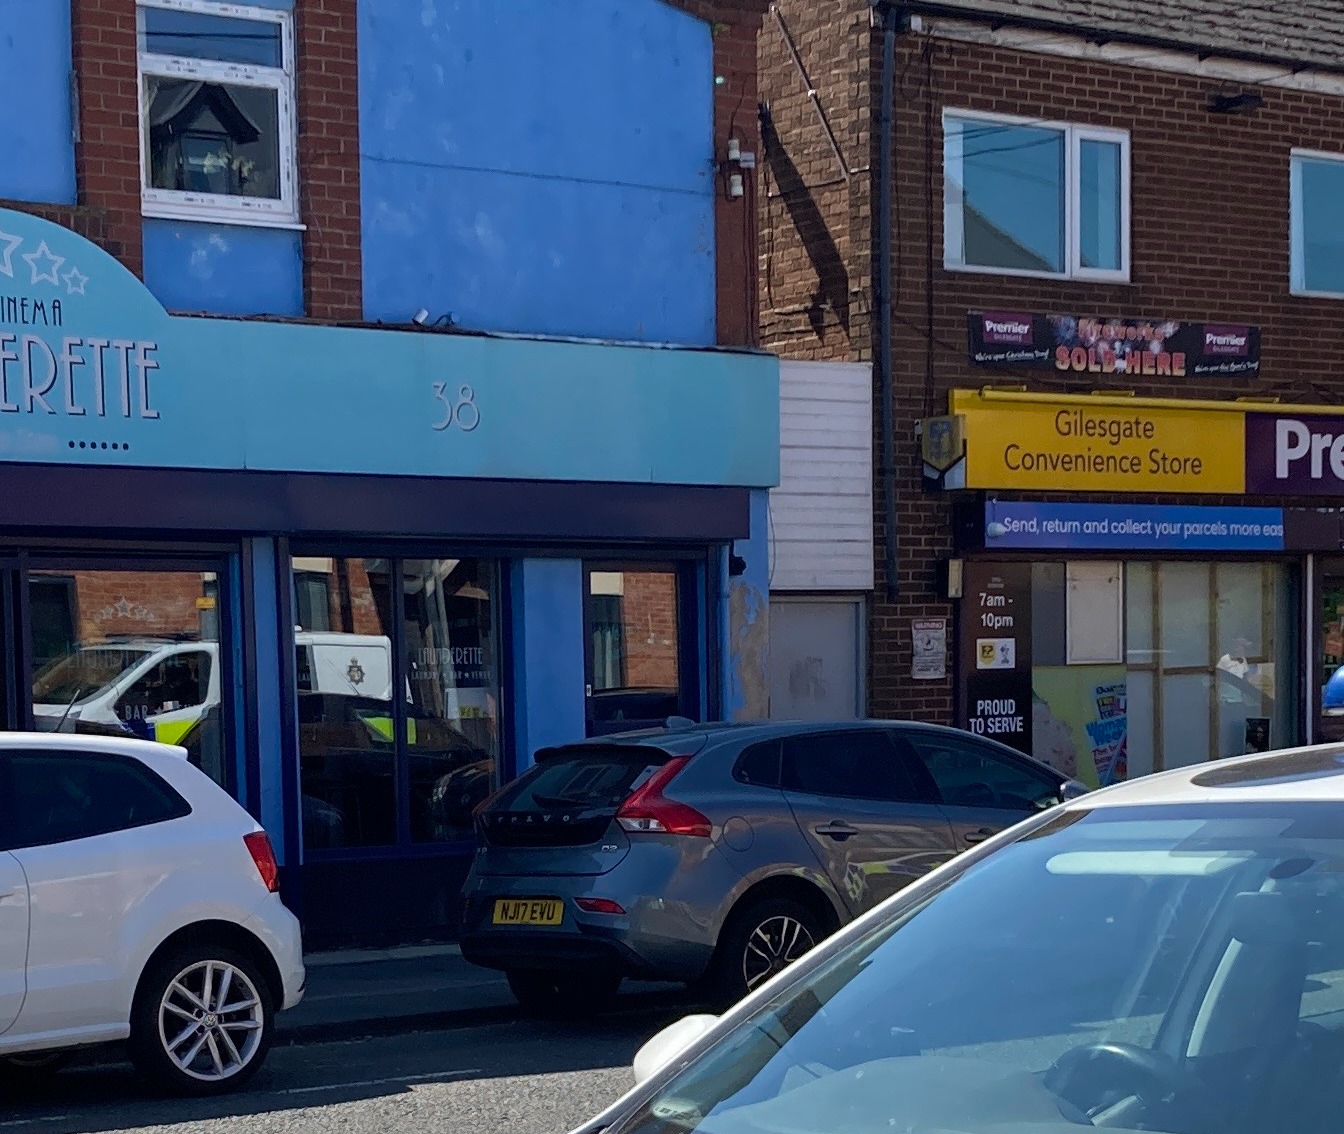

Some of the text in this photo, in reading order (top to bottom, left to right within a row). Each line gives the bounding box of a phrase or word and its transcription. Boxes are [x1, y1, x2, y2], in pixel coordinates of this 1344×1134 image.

[984, 320, 1030, 335] Premier
[1205, 332, 1247, 346] Premier
[1055, 345, 1117, 374] SOLD
[1125, 350, 1186, 377] HERE
[431, 380, 481, 432] 38
[1055, 410, 1155, 446] Gilesgate
[1004, 443, 1202, 475] Convenience Store
[1003, 517, 1040, 535] Send,
[1042, 519, 1081, 534] return
[1083, 518, 1109, 534] and
[1111, 518, 1153, 535] collect
[1155, 522, 1184, 539] your
[1184, 519, 1228, 539] parcels
[1229, 523, 1261, 536] more
[978, 592, 1005, 607] 7am
[981, 612, 1014, 630] 10pm
[976, 699, 1016, 716] PROUD
[969, 716, 1024, 734] TO SERVE
[500, 901, 556, 921] NJ17 EVU
